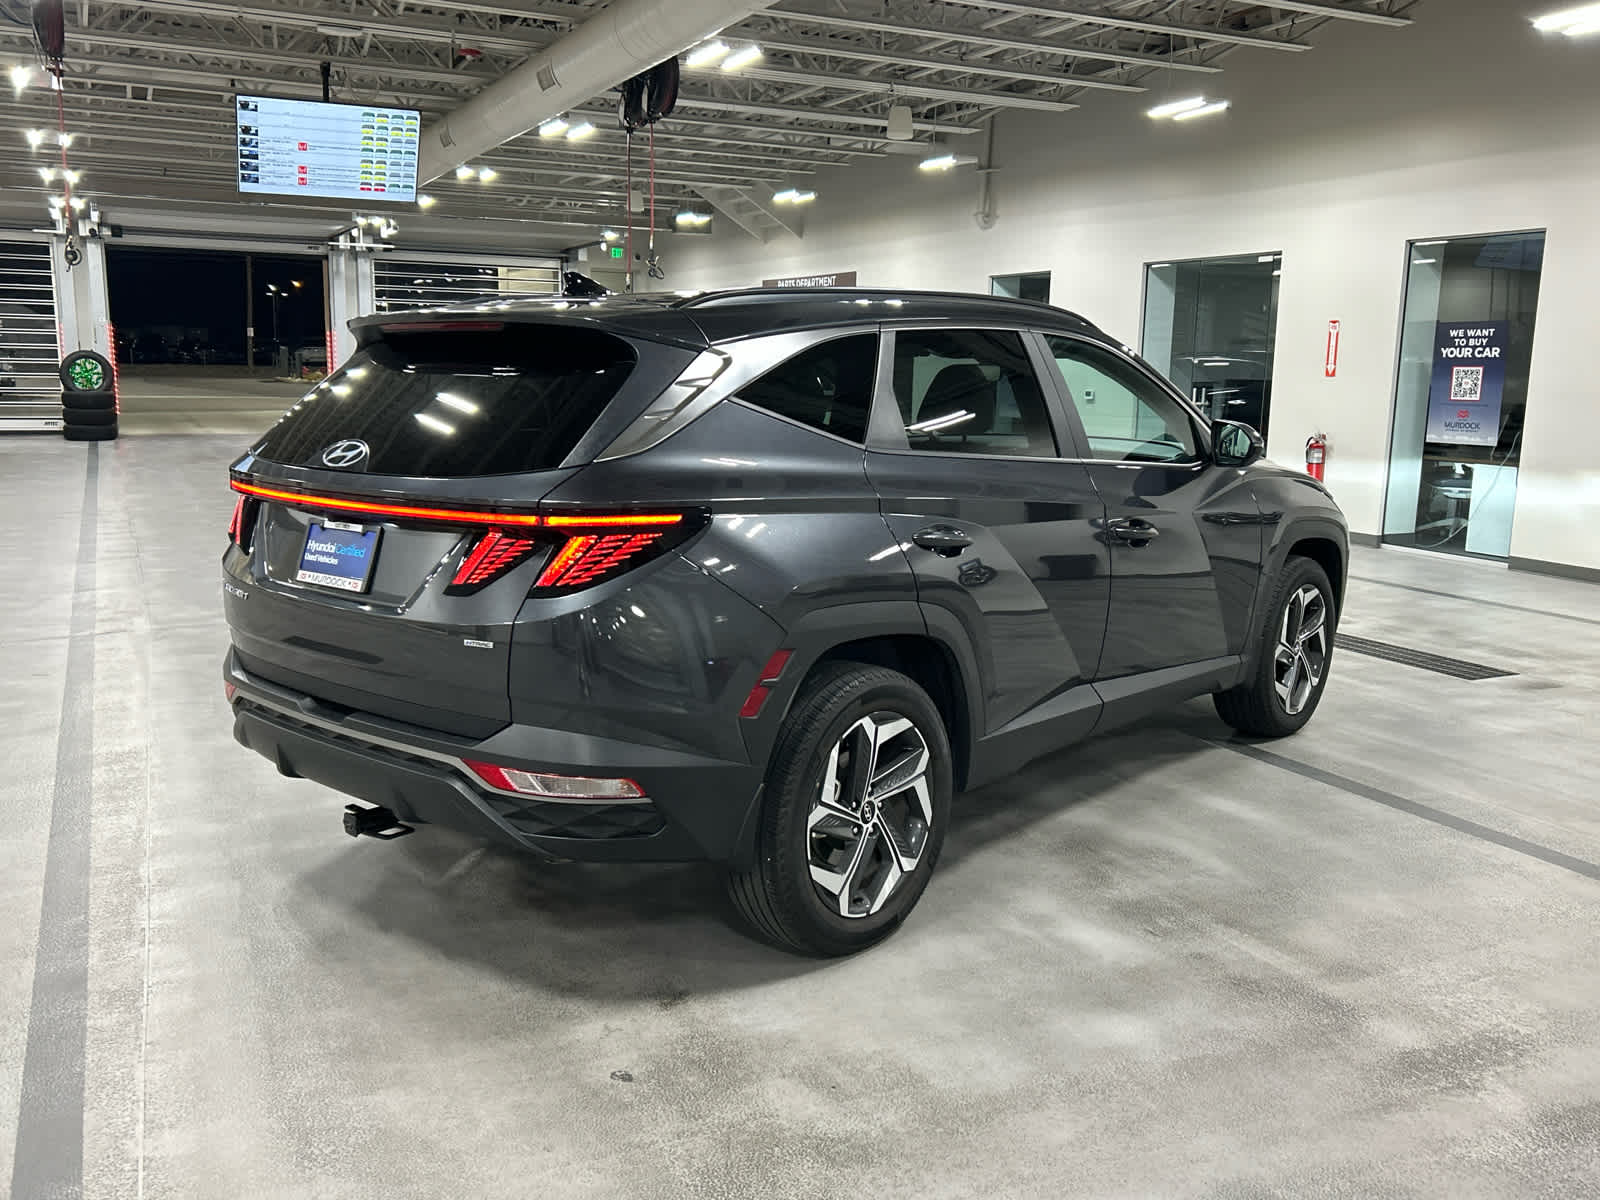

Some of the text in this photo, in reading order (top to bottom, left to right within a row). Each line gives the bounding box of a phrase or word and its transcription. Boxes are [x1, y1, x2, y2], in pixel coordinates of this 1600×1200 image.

[1449, 328, 1496, 337] WE WANT
[1454, 338, 1489, 346] TO BUY
[1441, 347, 1501, 358] YOUR CAR
[1444, 421, 1481, 430] MURDOCK
[307, 539, 337, 553] Hyundai
